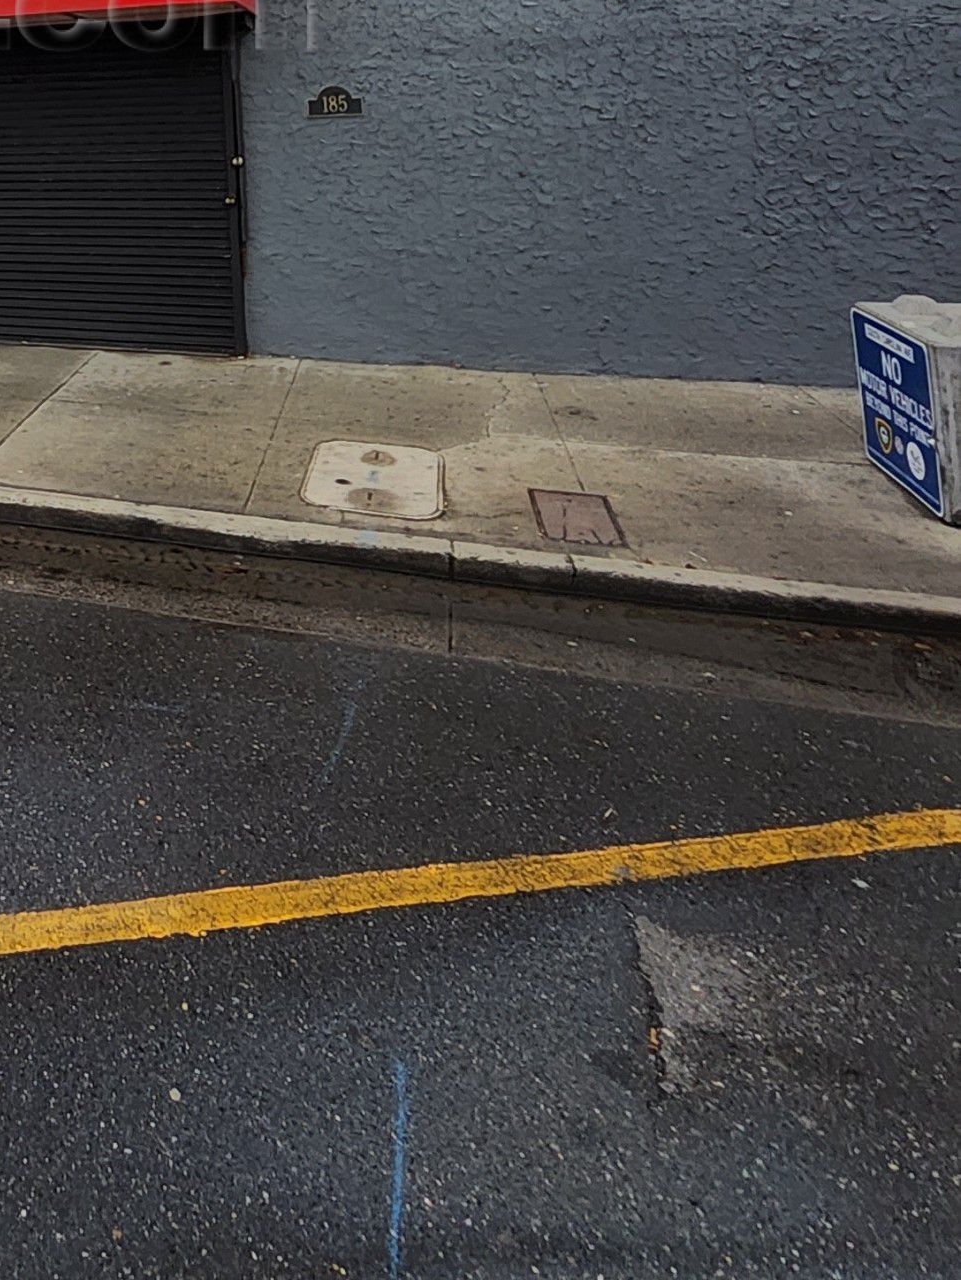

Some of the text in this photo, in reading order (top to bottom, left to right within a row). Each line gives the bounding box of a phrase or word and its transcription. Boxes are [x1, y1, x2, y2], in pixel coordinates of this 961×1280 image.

[322, 94, 348, 113] 185
[881, 350, 902, 386] NO
[889, 385, 934, 431] VEHICLES
